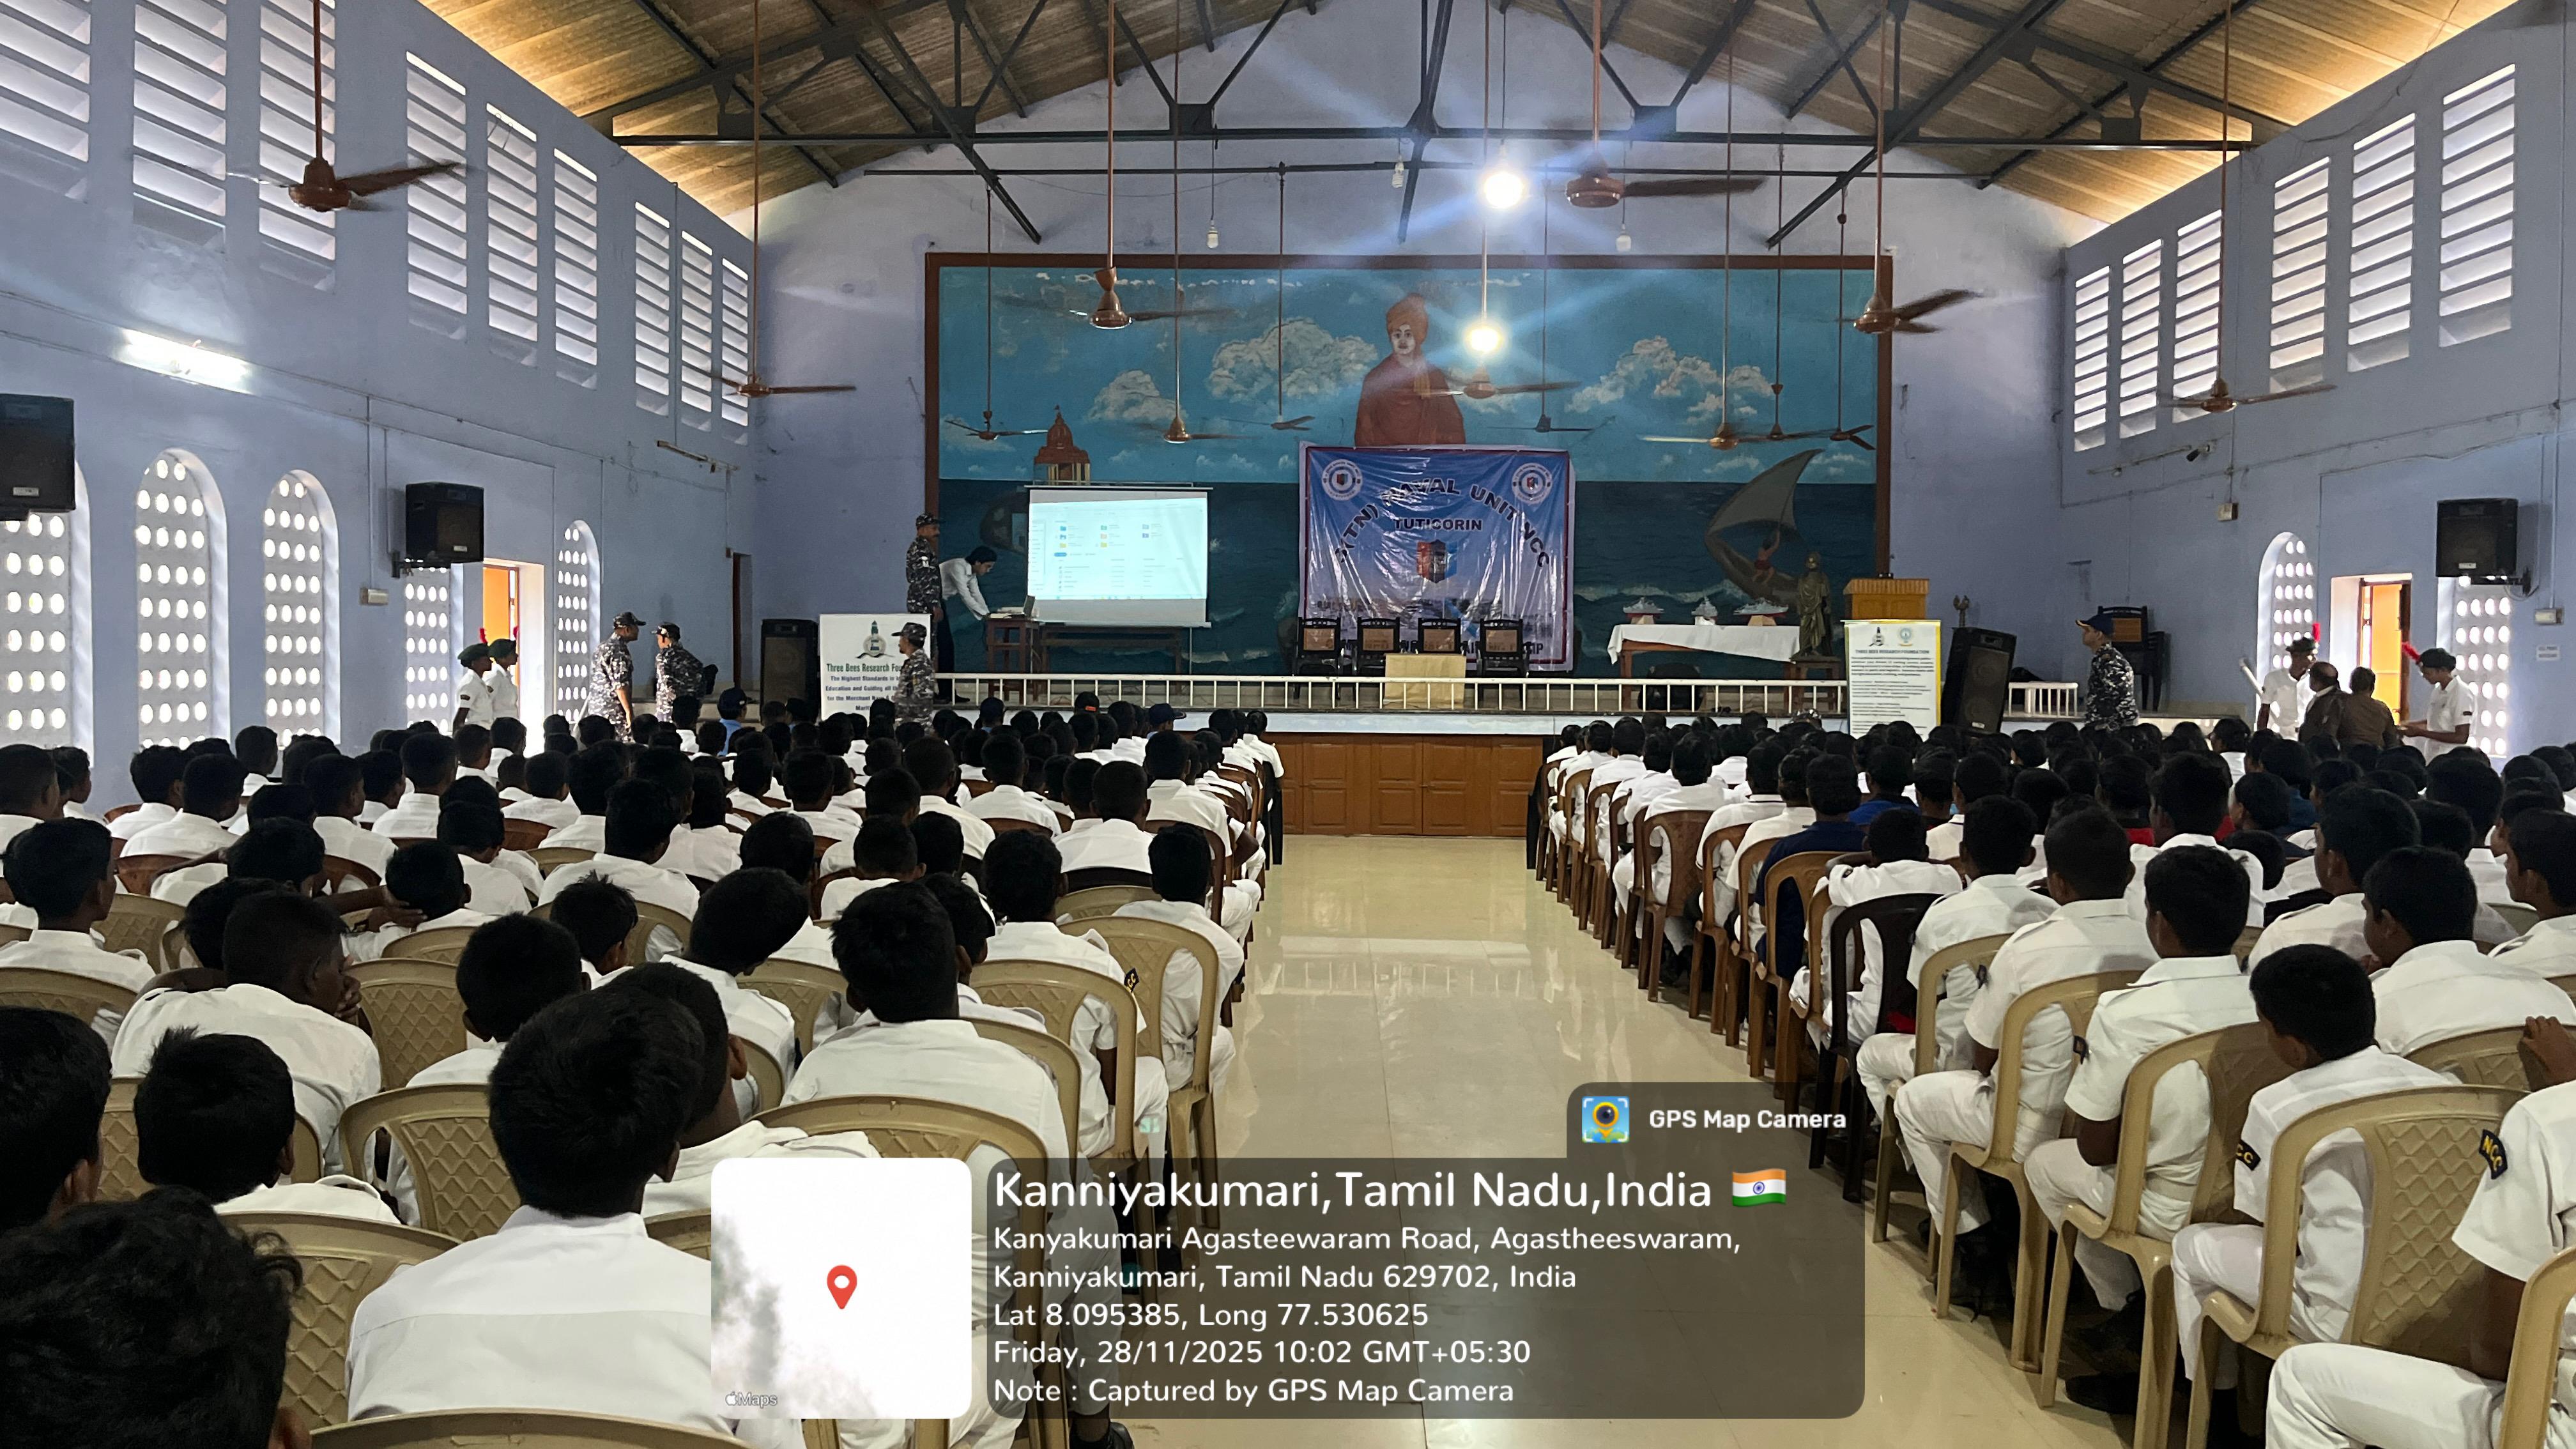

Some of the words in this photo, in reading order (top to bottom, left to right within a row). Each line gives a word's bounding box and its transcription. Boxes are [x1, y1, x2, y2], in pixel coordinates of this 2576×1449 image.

[1470, 484, 1519, 521] UNIT
[1394, 518, 1482, 530] TUTICORIN
[827, 663, 843, 671] Three
[845, 663, 860, 671] Bees
[862, 663, 889, 671] Research
[2236, 1144, 2253, 1163] CC
[2483, 1135, 2503, 1171] NCC
